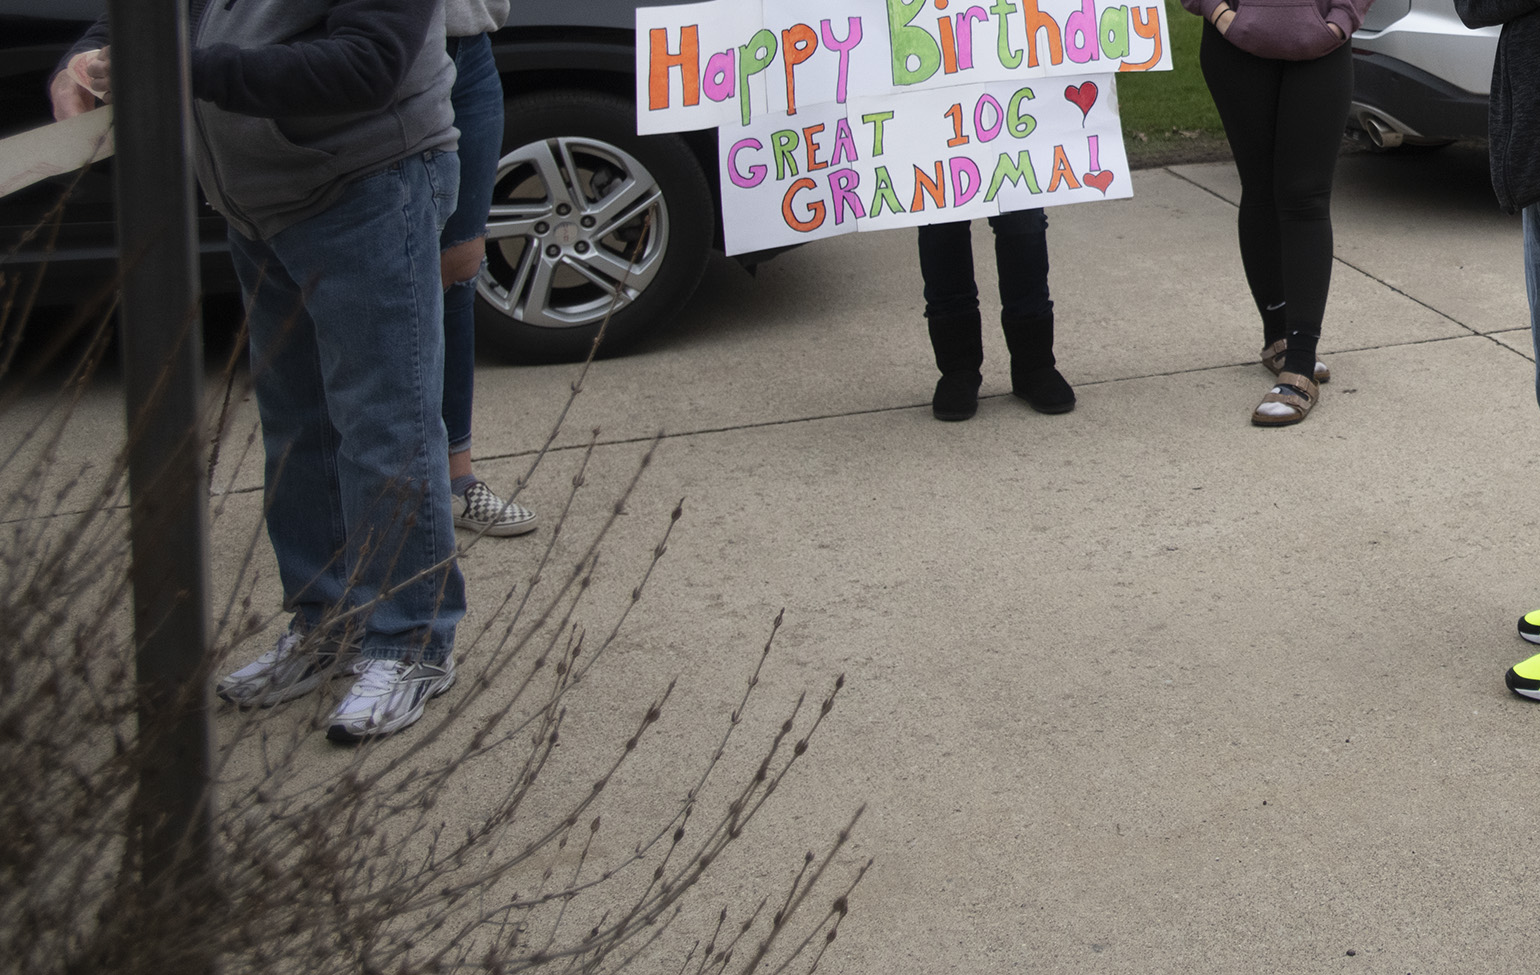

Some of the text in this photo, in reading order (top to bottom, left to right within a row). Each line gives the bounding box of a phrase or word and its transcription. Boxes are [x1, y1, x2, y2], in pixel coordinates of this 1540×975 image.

[648, 14, 862, 126] Happy
[727, 87, 1037, 189] GREAT 106
